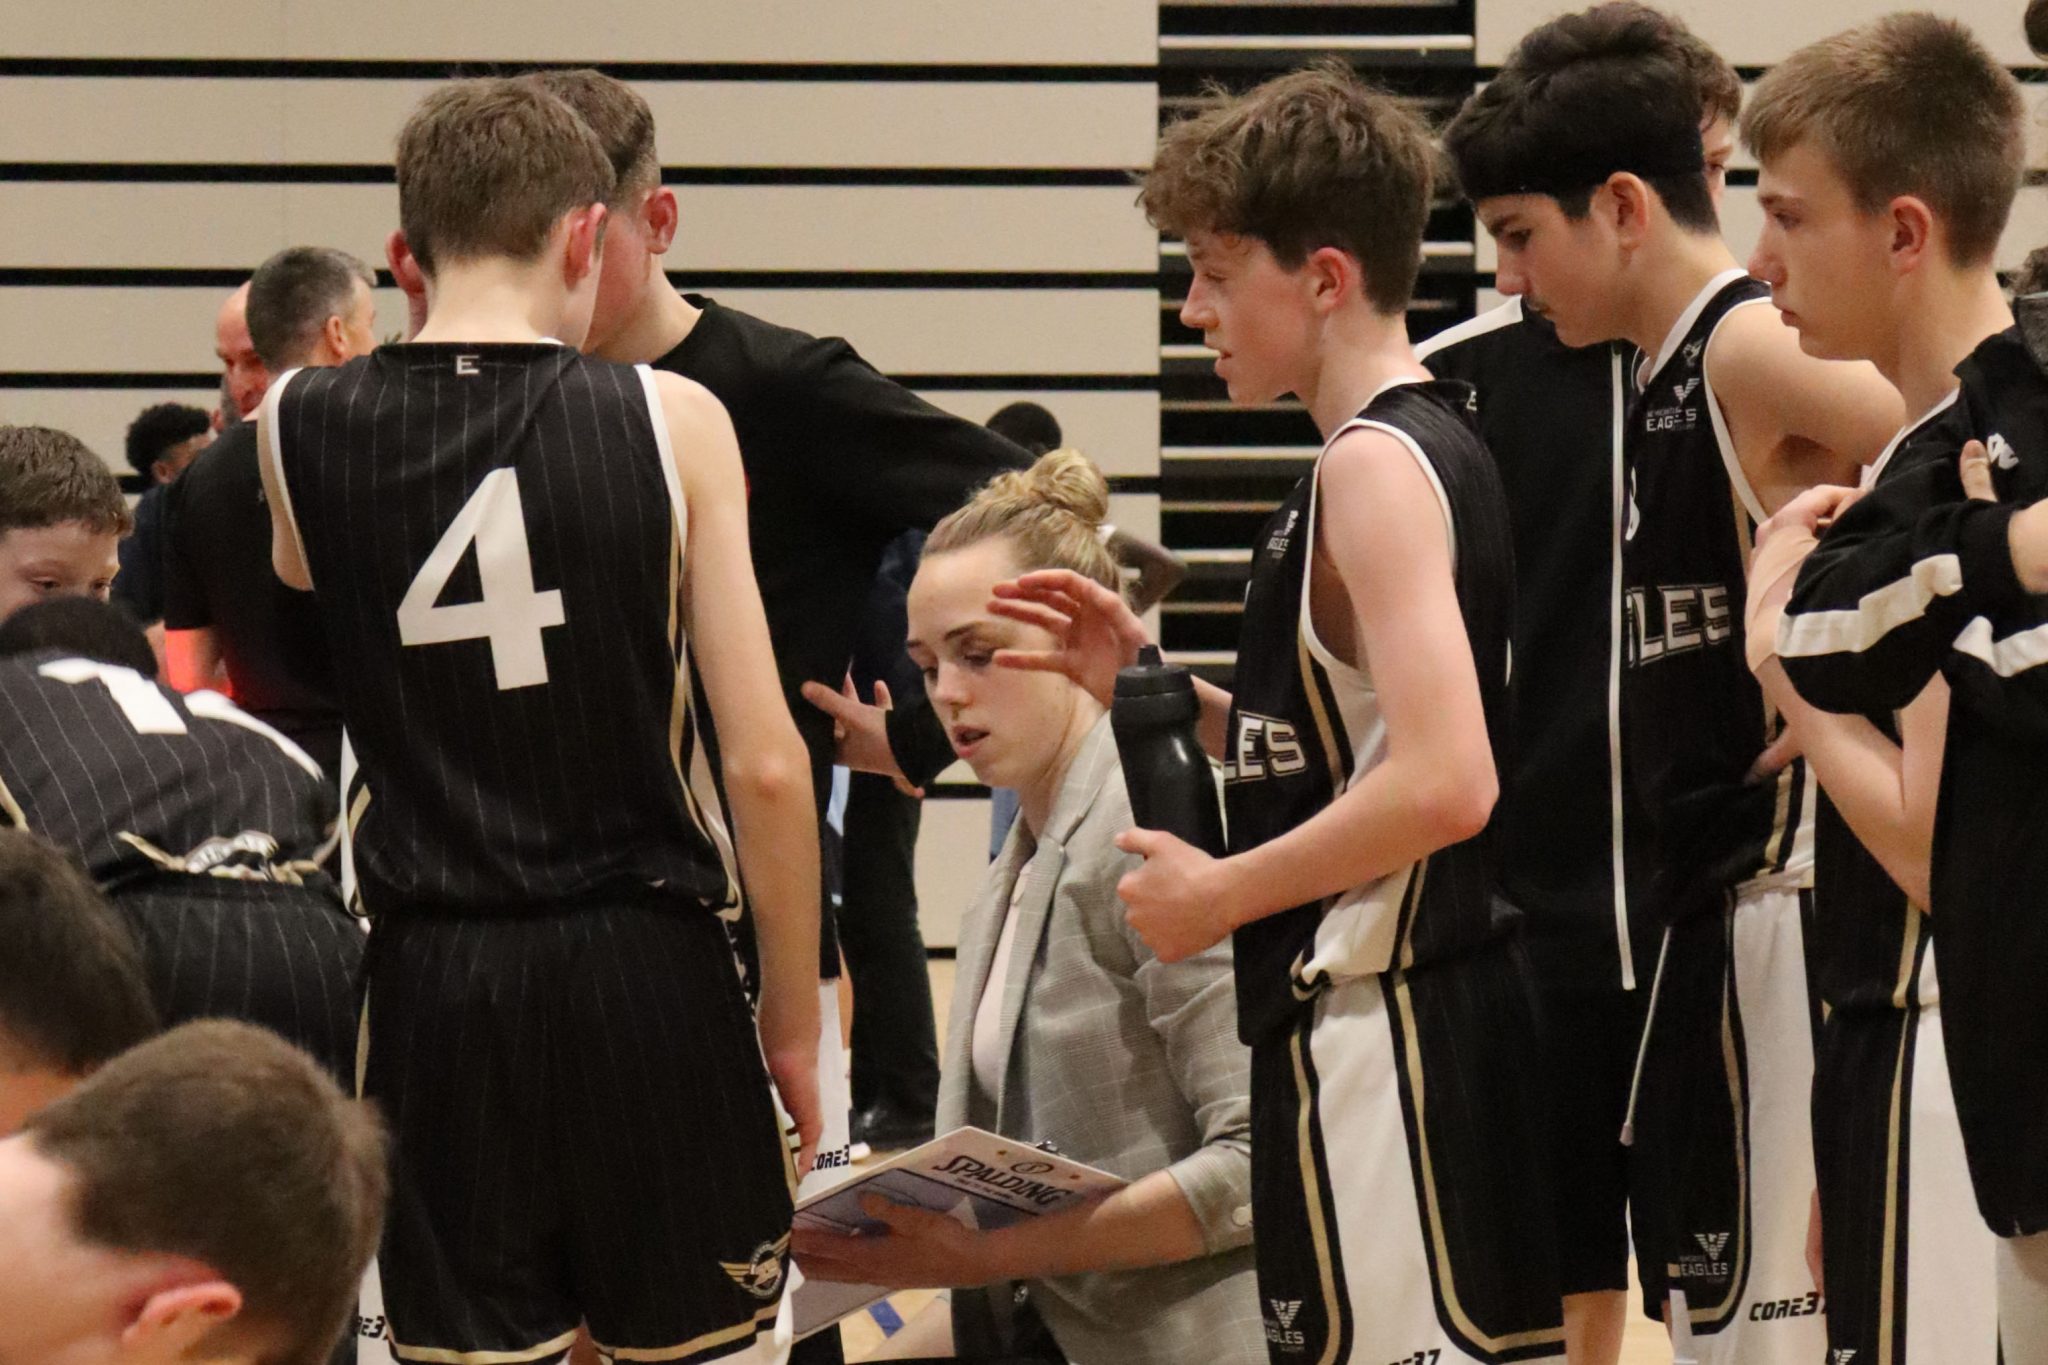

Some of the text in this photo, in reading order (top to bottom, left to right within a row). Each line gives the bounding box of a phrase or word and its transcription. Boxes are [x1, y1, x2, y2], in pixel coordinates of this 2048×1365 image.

[456, 355, 479, 374] E
[397, 466, 565, 691] 4
[1625, 583, 1731, 667] LES
[811, 1144, 849, 1171] ORE3
[931, 1155, 1074, 1205] SPALDING
[1680, 1262, 1728, 1276] EAGLES
